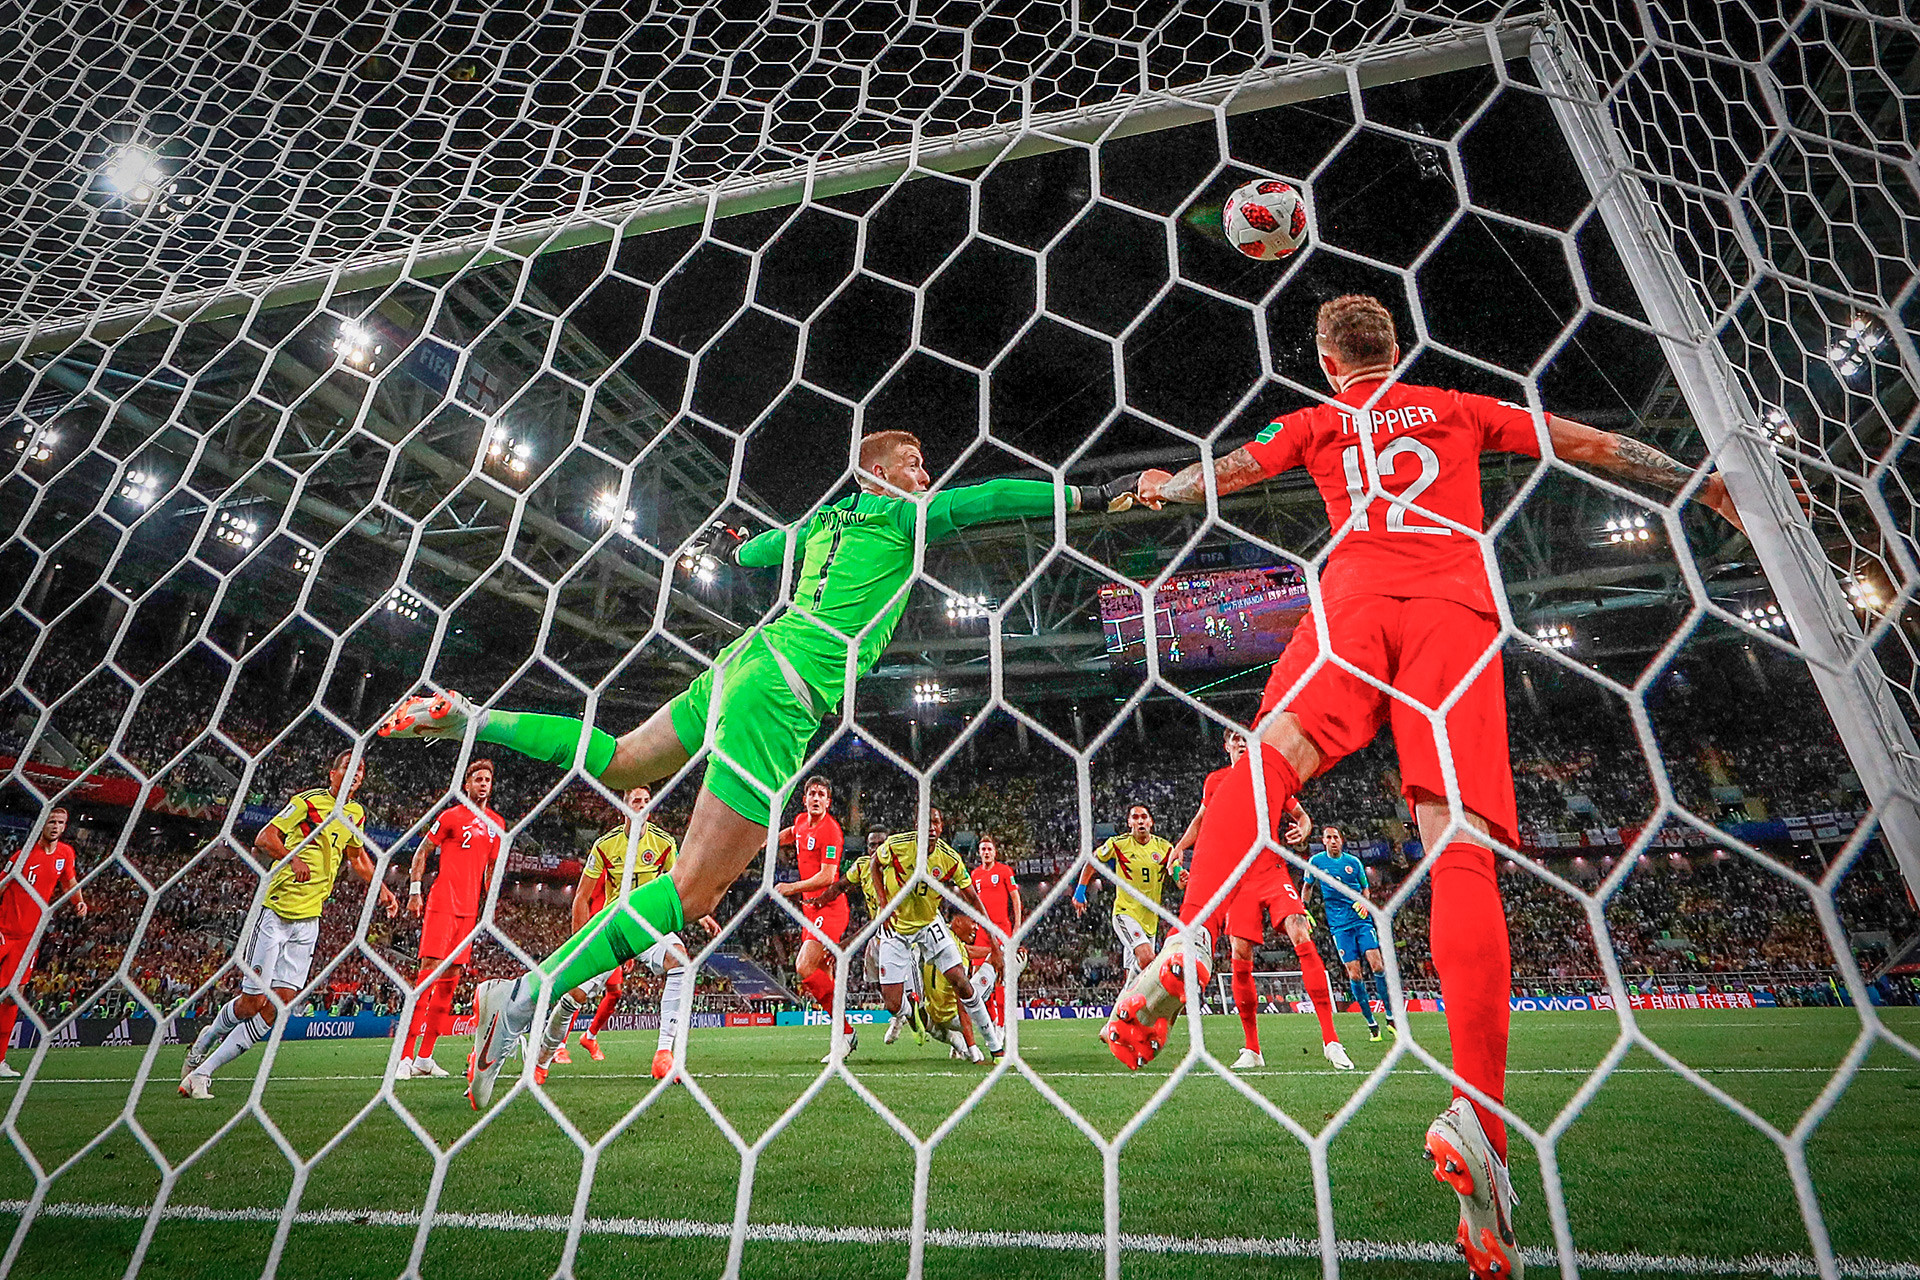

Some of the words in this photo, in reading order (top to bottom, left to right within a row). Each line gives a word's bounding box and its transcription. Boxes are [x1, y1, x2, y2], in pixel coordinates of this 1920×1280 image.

[420, 346, 452, 379] FIFA
[1342, 436, 1452, 536] 12
[331, 833, 339, 847] 7
[462, 831, 472, 848] 2
[28, 870, 37, 885] 4
[1142, 868, 1150, 882] 9
[915, 881, 928, 896] 13
[1283, 884, 1298, 900] 5
[814, 916, 824, 928] 6
[927, 923, 946, 944] 13
[1509, 1000, 1538, 1011] vo
[1538, 997, 1588, 1011] vivo
[804, 1010, 874, 1025] Hisnse
[1029, 1007, 1062, 1020] VISA
[1072, 1006, 1105, 1019] VISA
[306, 1021, 355, 1037] MOSCOW
[573, 1018, 594, 1030] HYUN
[634, 1013, 662, 1030] AIRWAY
[101, 1038, 133, 1047] adidas
